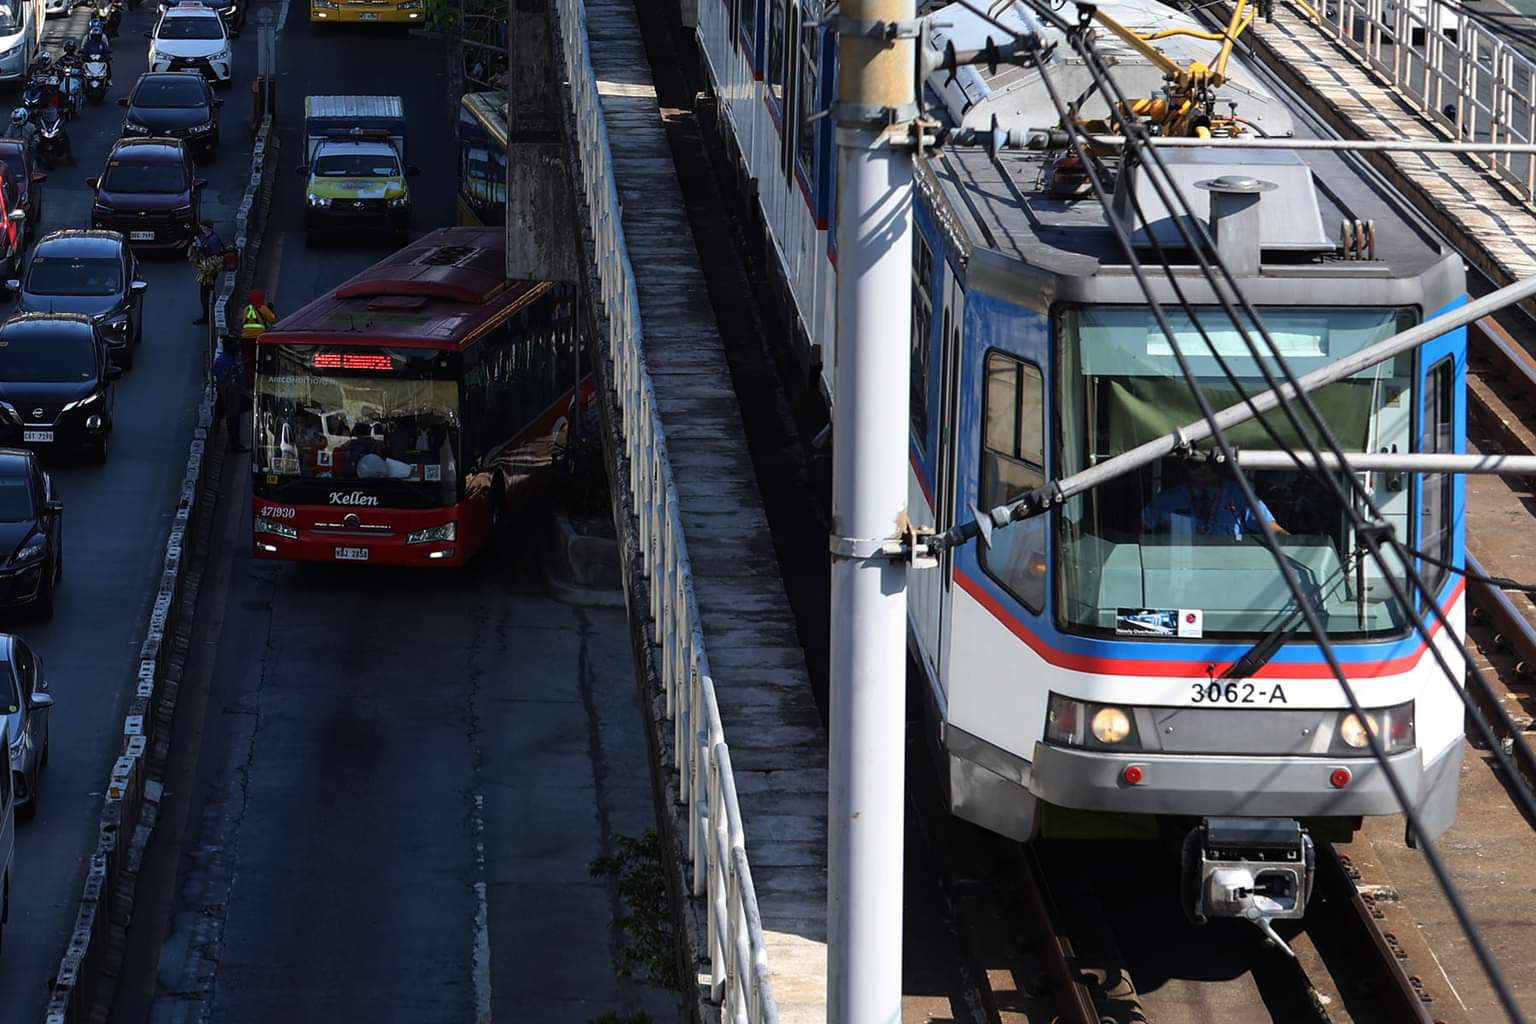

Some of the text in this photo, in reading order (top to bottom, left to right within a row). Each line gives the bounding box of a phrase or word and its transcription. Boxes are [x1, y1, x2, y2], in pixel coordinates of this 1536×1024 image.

[328, 492, 378, 506] Kellen
[260, 506, 296, 517] 471930
[1191, 683, 1287, 704] 3062-A
